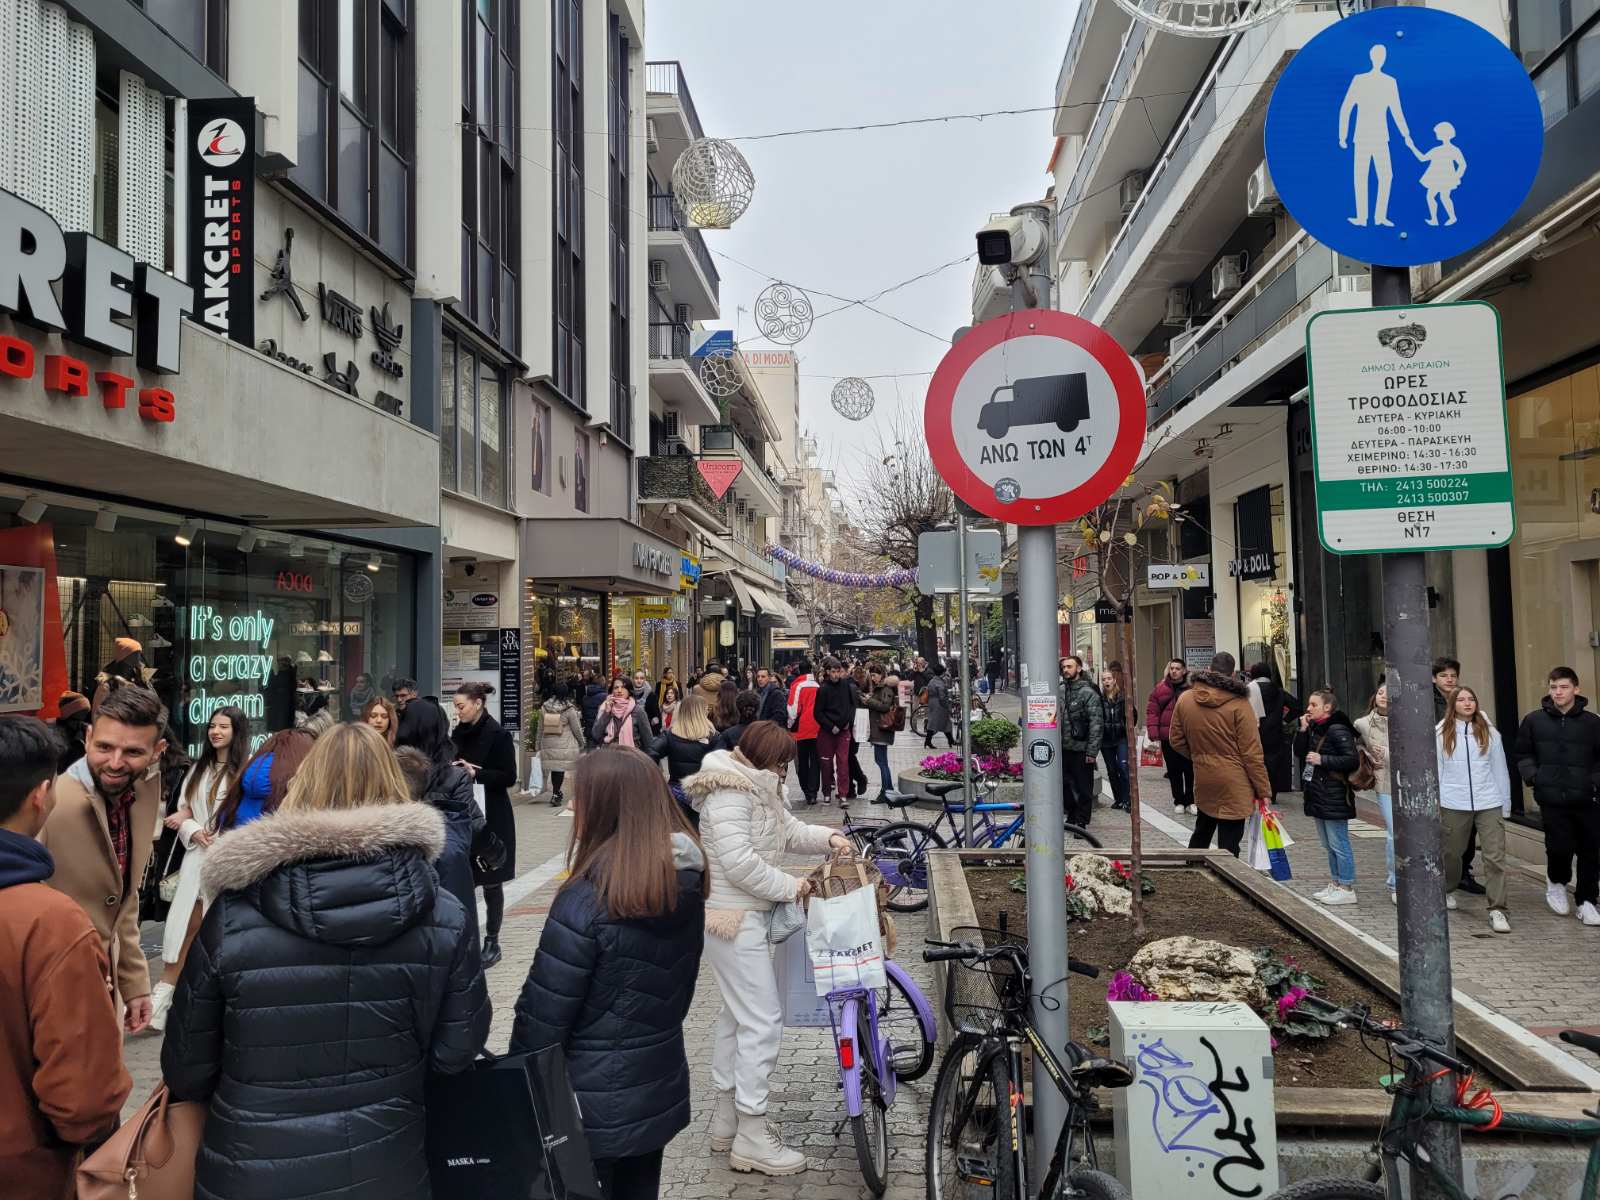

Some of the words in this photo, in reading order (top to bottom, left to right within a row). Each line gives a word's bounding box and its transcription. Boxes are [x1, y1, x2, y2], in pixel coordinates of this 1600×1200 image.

[231, 179, 241, 273] SPORTS
[204, 175, 229, 338] AKCRET
[318, 282, 363, 339] VANS
[764, 352, 790, 364] MODA
[1361, 363, 1395, 373] ΔΗΜΟΣ
[1399, 360, 1450, 371] ΛΑΡΙΣΑΙΩΝ
[1384, 374, 1428, 390] ΩΡΕΣ
[1347, 390, 1468, 410] ΤΡΟΦΟΔΟΣΙΑΣ
[1357, 413, 1404, 424] ΔΕΥΤΕΡΑ
[1414, 410, 1461, 421] ΚΥΡΙΑΚΗ
[1351, 439, 1398, 449] ΔΕΥΤΕΡΑ
[1408, 435, 1471, 446] ΠΑΡΑΣΚΕΥΗ
[980, 442, 1019, 464] ΑΝΩ
[1027, 438, 1066, 460] ΤΩΝ
[1347, 451, 1410, 462] ΧΕΙΜΕΡΙΝΟ:
[702, 462, 737, 471] Unicorn
[1358, 464, 1401, 474] ΘΕΡΙΝΟ:
[1360, 482, 1388, 492] ΤΗΛ:
[1396, 480, 1423, 490] 2413
[1426, 478, 1468, 489] 500224
[1397, 493, 1424, 504] 2413
[1428, 491, 1469, 502] 500307
[1398, 510, 1435, 523] ΘΕΣΗ
[1250, 554, 1271, 573] DOLL
[1151, 572, 1169, 580] POP
[190, 605, 223, 641] It's
[229, 610, 274, 649] only
[190, 655, 206, 682] a
[212, 654, 274, 686] crazy
[447, 1157, 475, 1167] MASKA
